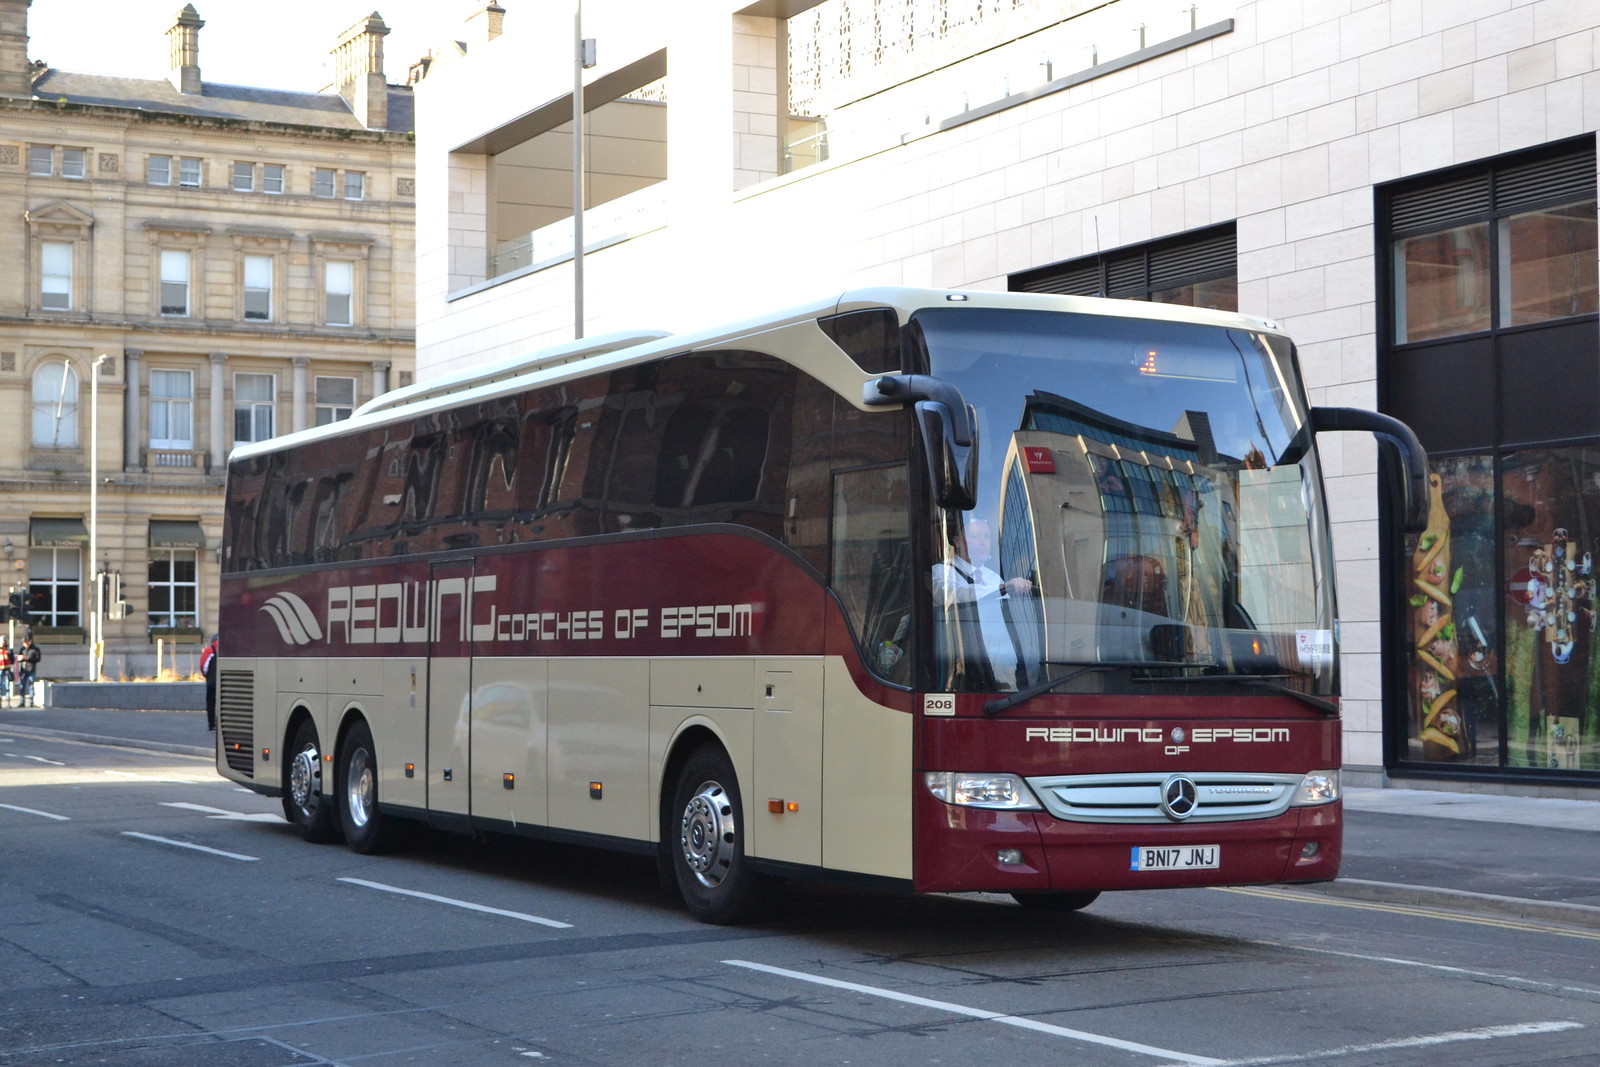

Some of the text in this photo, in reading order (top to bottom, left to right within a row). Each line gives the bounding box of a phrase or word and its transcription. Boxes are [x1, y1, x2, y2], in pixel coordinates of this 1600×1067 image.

[327, 575, 752, 644] REDWING COACHES OF EPSOM
[926, 700, 952, 709] 208
[1026, 727, 1290, 742] REDWING EPSOM
[1164, 745, 1190, 755] OF
[1209, 786, 1272, 794] TOURISMO
[1145, 848, 1215, 867] BN17 JNJ
